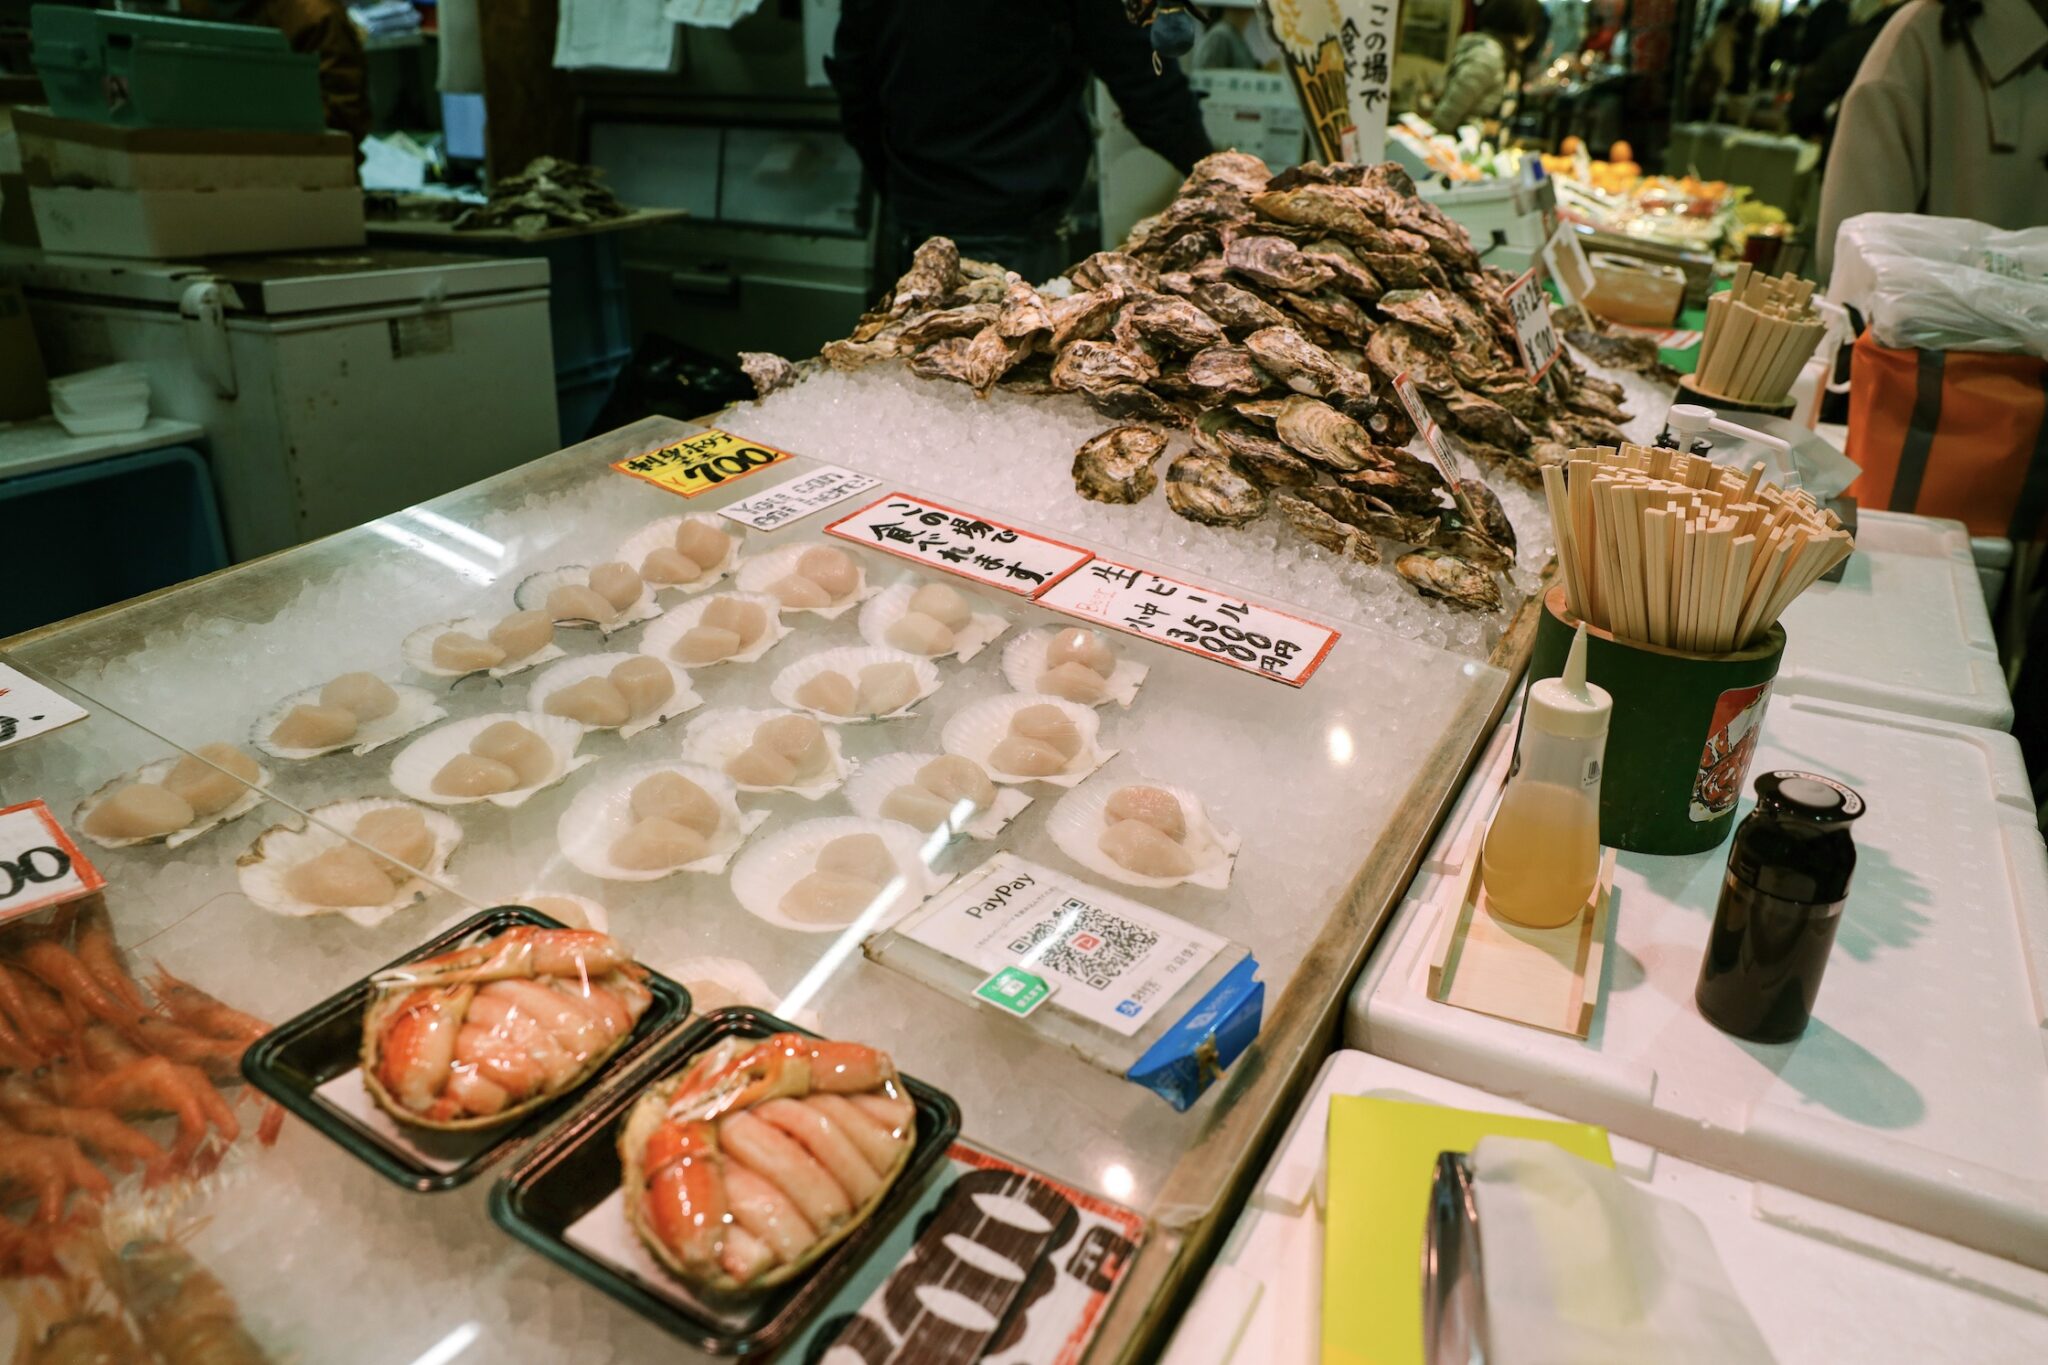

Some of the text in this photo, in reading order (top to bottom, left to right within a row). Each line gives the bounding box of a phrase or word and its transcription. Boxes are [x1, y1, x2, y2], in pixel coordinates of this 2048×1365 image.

[1359, 4, 1389, 113] この場で
[729, 473, 844, 515] You can
[751, 475, 875, 528] eat here!
[887, 503, 1018, 543] この場で
[1091, 565, 1249, 623] 生ビール
[1123, 616, 1289, 675] 小300円
[1134, 601, 1302, 660] 中500円
[965, 873, 1035, 919] PayPay
